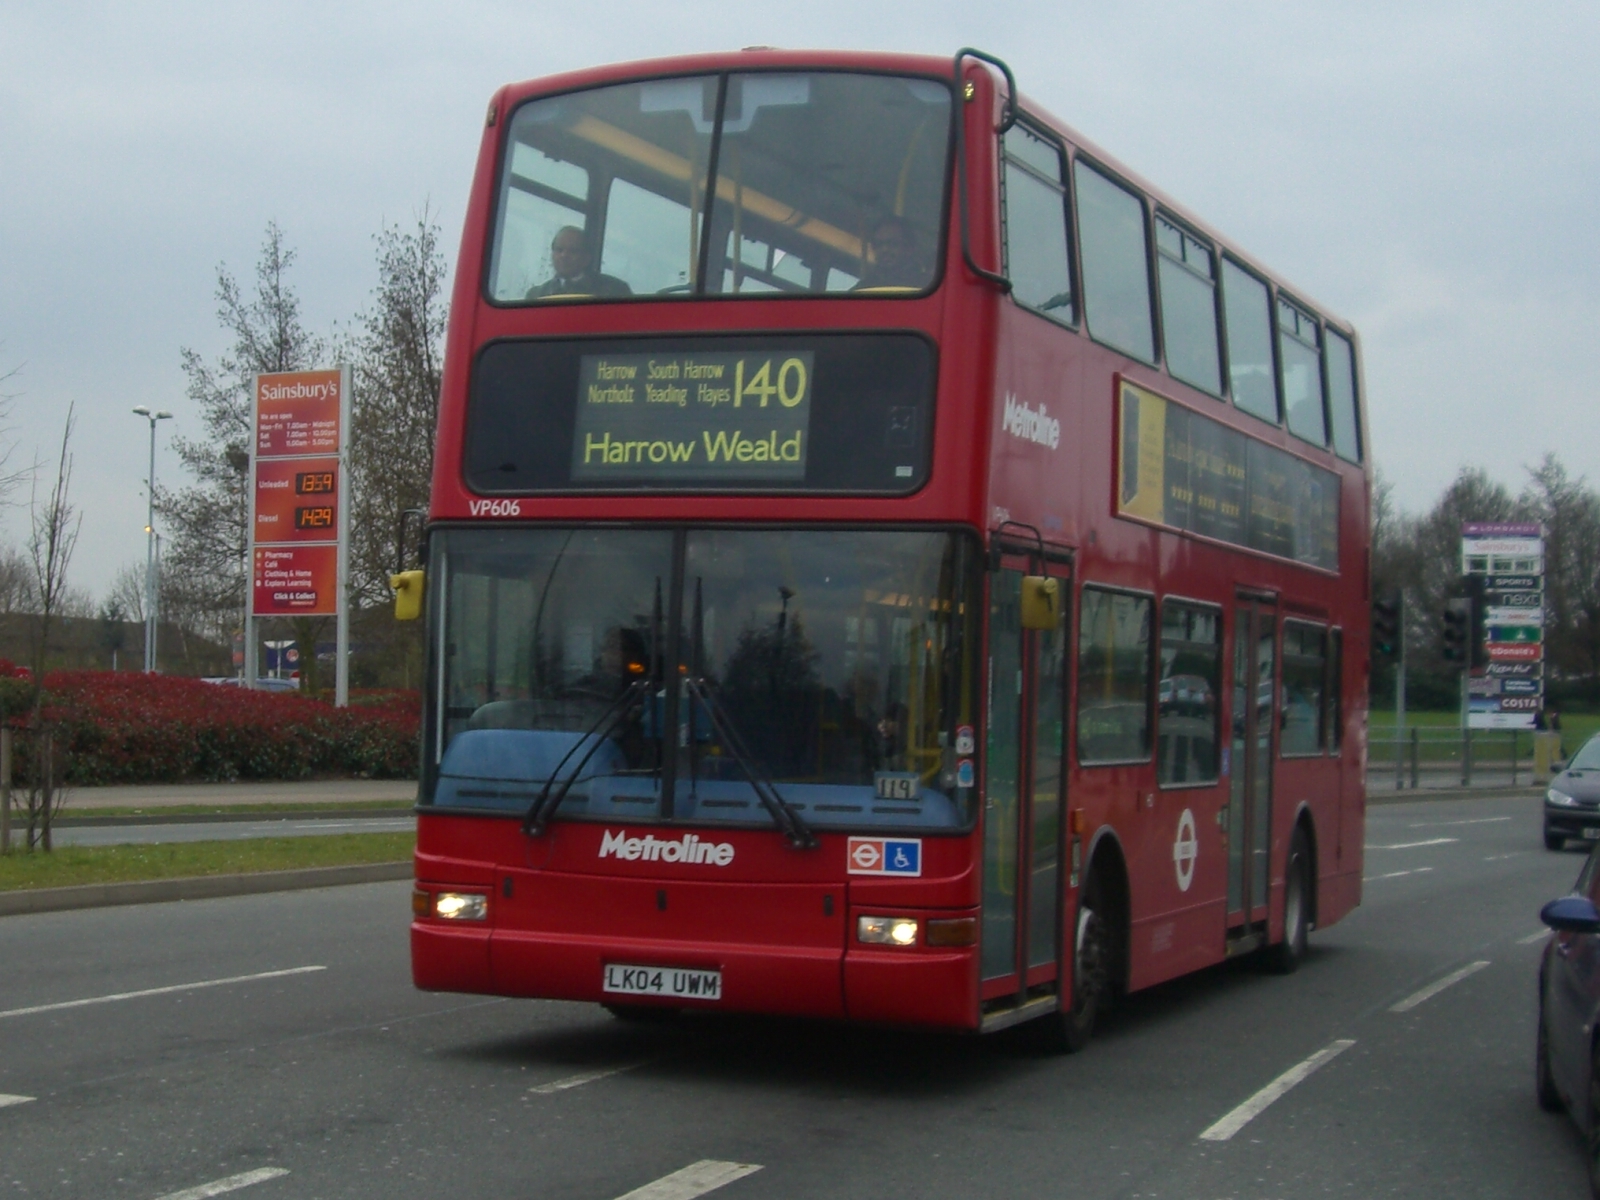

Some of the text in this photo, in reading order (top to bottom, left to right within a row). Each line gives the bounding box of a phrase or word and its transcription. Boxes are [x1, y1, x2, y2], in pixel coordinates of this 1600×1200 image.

[597, 360, 725, 380] Harrow South Harrow
[261, 380, 337, 401] Sainsbury's
[733, 357, 807, 408] 140
[588, 384, 731, 407] Northolt Yeading Hayes
[1003, 390, 1060, 450] Metroline
[583, 430, 802, 463] Harrow Weald
[258, 480, 289, 488] Unleaded
[258, 508, 332, 526] Diesel 1429
[468, 499, 521, 516] VP606
[264, 570, 288, 578] Clothing
[273, 592, 288, 600] Click
[295, 592, 316, 600] Collect
[1502, 698, 1538, 708] COSTA
[878, 779, 910, 799] 119
[598, 829, 735, 866] Metroline
[607, 967, 719, 996] LK04 UWM
